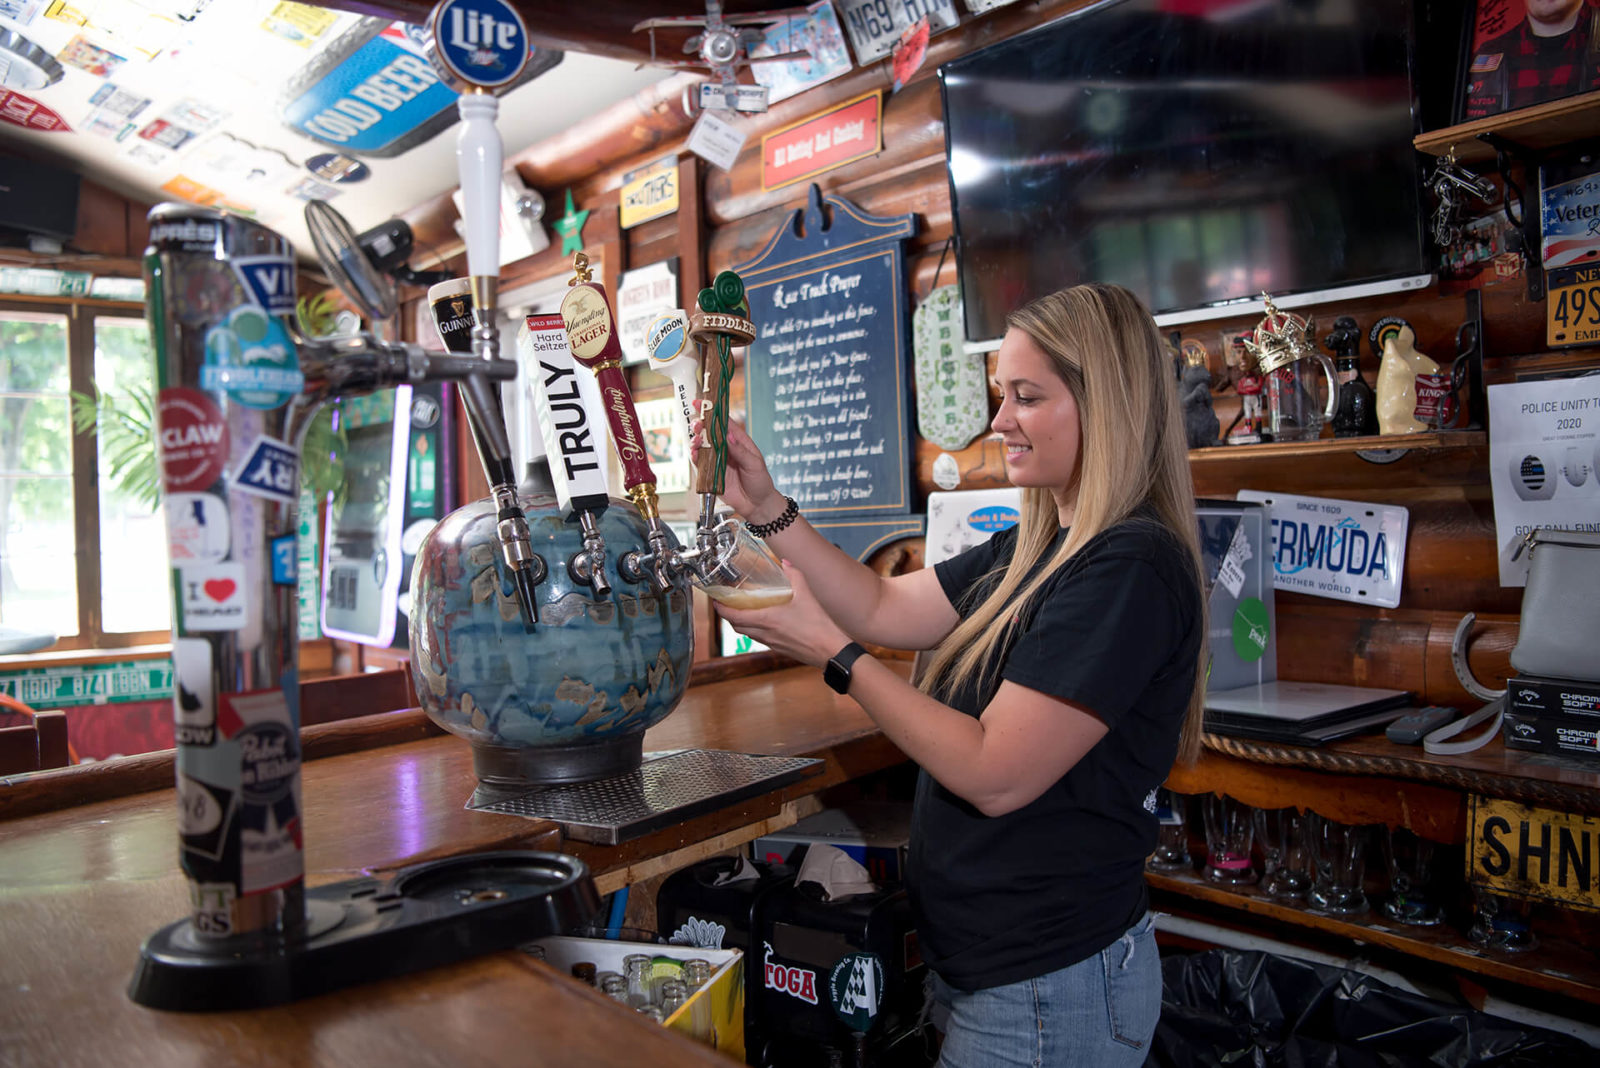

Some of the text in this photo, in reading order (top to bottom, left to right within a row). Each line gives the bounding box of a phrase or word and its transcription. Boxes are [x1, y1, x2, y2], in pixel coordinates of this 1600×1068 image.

[450, 7, 518, 51] Lite
[304, 54, 440, 142] COLD BEER
[565, 307, 605, 335] Yuengling
[660, 317, 683, 336] MOON
[533, 342, 568, 352] Seltzer
[536, 333, 563, 342] Hard
[571, 324, 607, 350] LAGER
[1521, 402, 1558, 415] POLICE
[1561, 398, 1591, 411] UNITY
[539, 360, 599, 481] TRULY
[604, 386, 646, 461] Yuengling
[1556, 417, 1582, 430] 2020
[162, 423, 223, 449] CLAW
[1297, 502, 1342, 515] SINCE 1609
[1271, 518, 1389, 580] ERMUDA
[1274, 575, 1352, 594] ANOTHER WORLD
[1563, 700, 1594, 709] SOFT
[1559, 735, 1590, 744] SOFT
[1480, 815, 1600, 895] SHN
[764, 963, 817, 1002] TOGA
